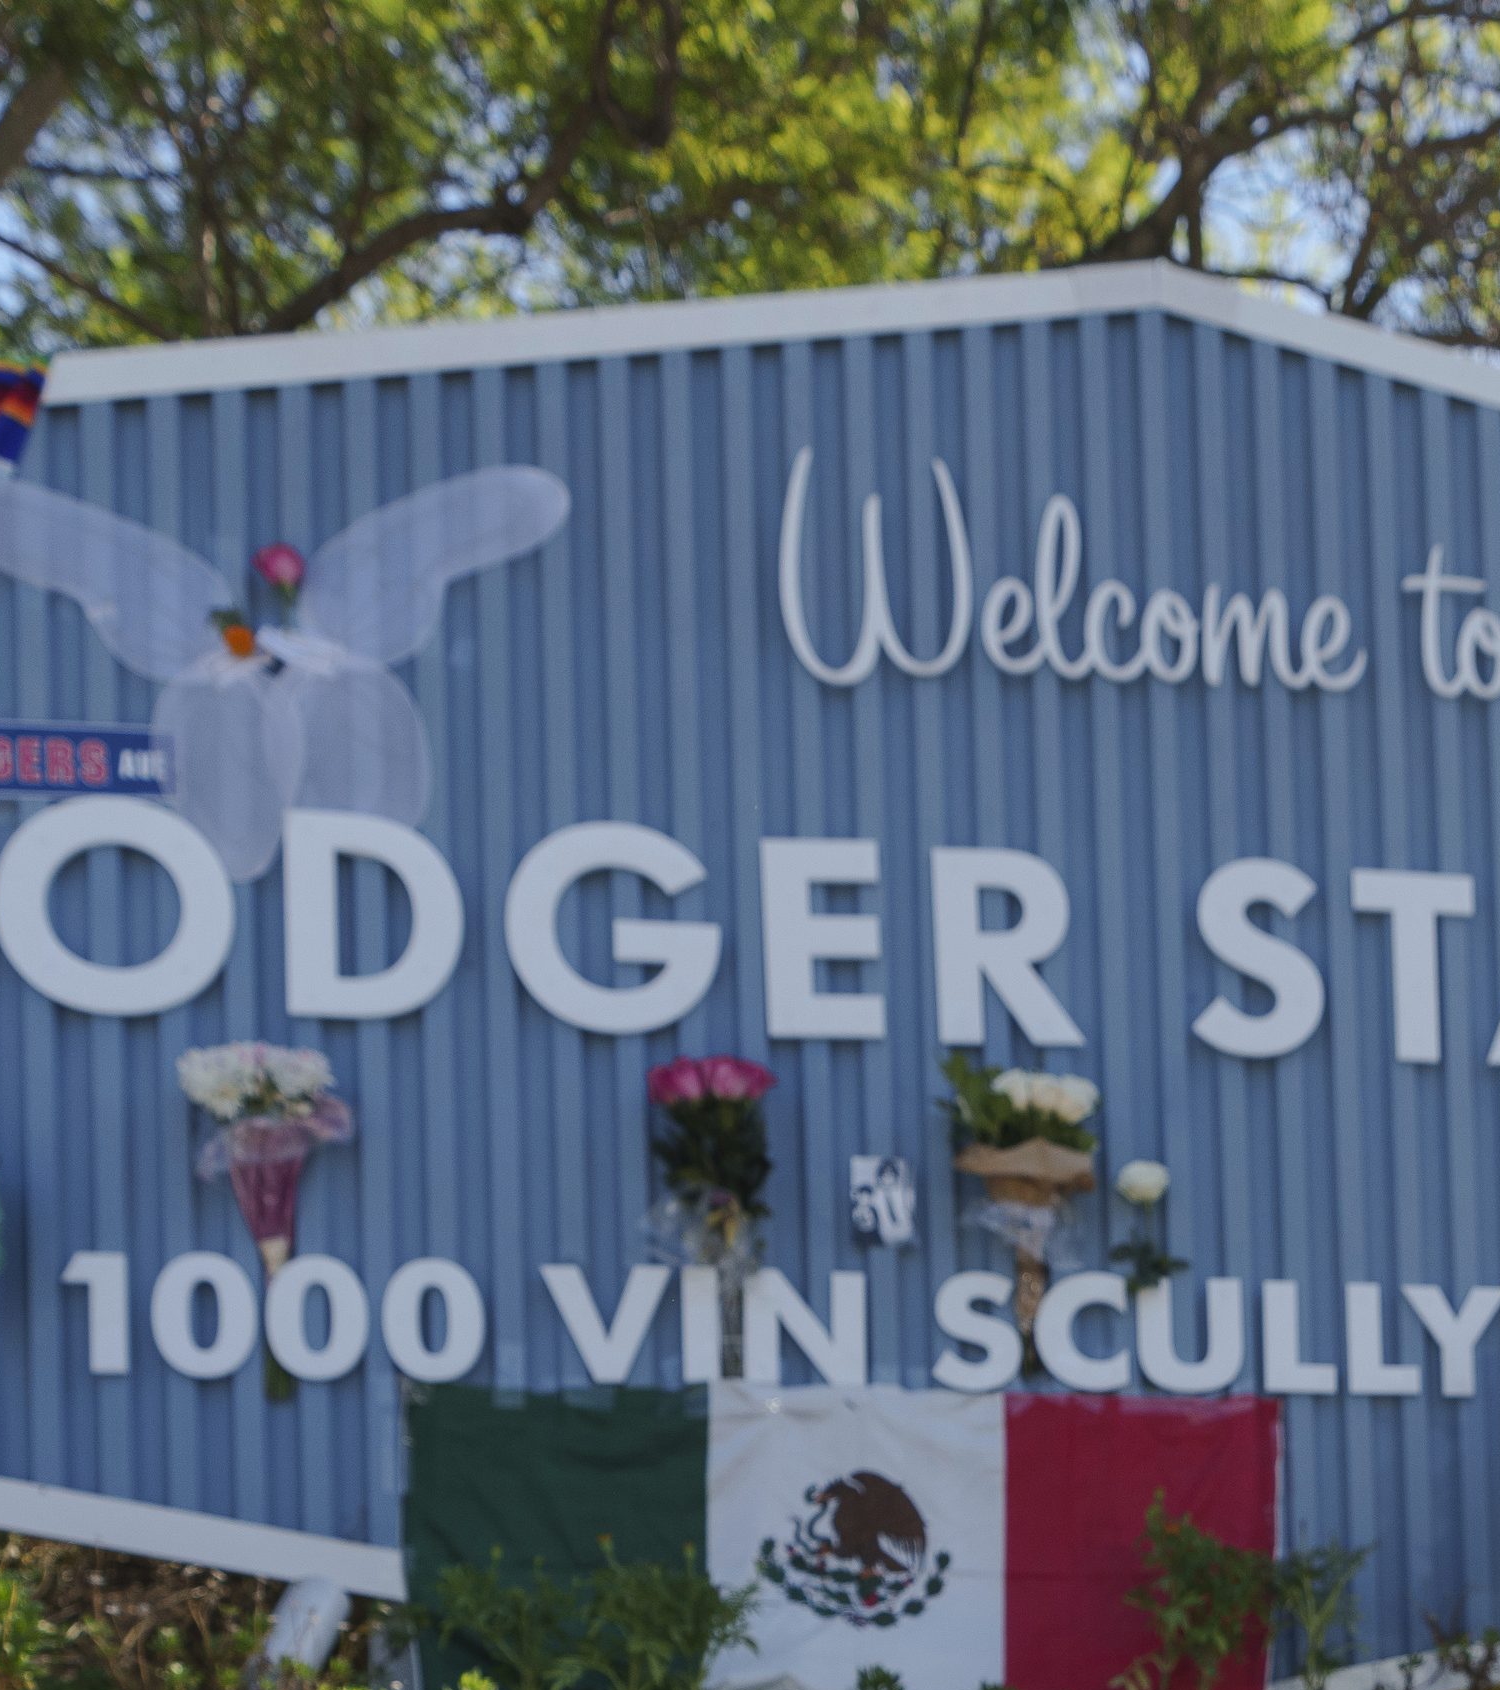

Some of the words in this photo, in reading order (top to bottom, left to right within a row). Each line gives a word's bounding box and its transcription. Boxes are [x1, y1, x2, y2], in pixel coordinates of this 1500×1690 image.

[778, 444, 1368, 693] Welcome
[60, 1250, 486, 1382] 1000
[540, 1263, 867, 1386] VIN
